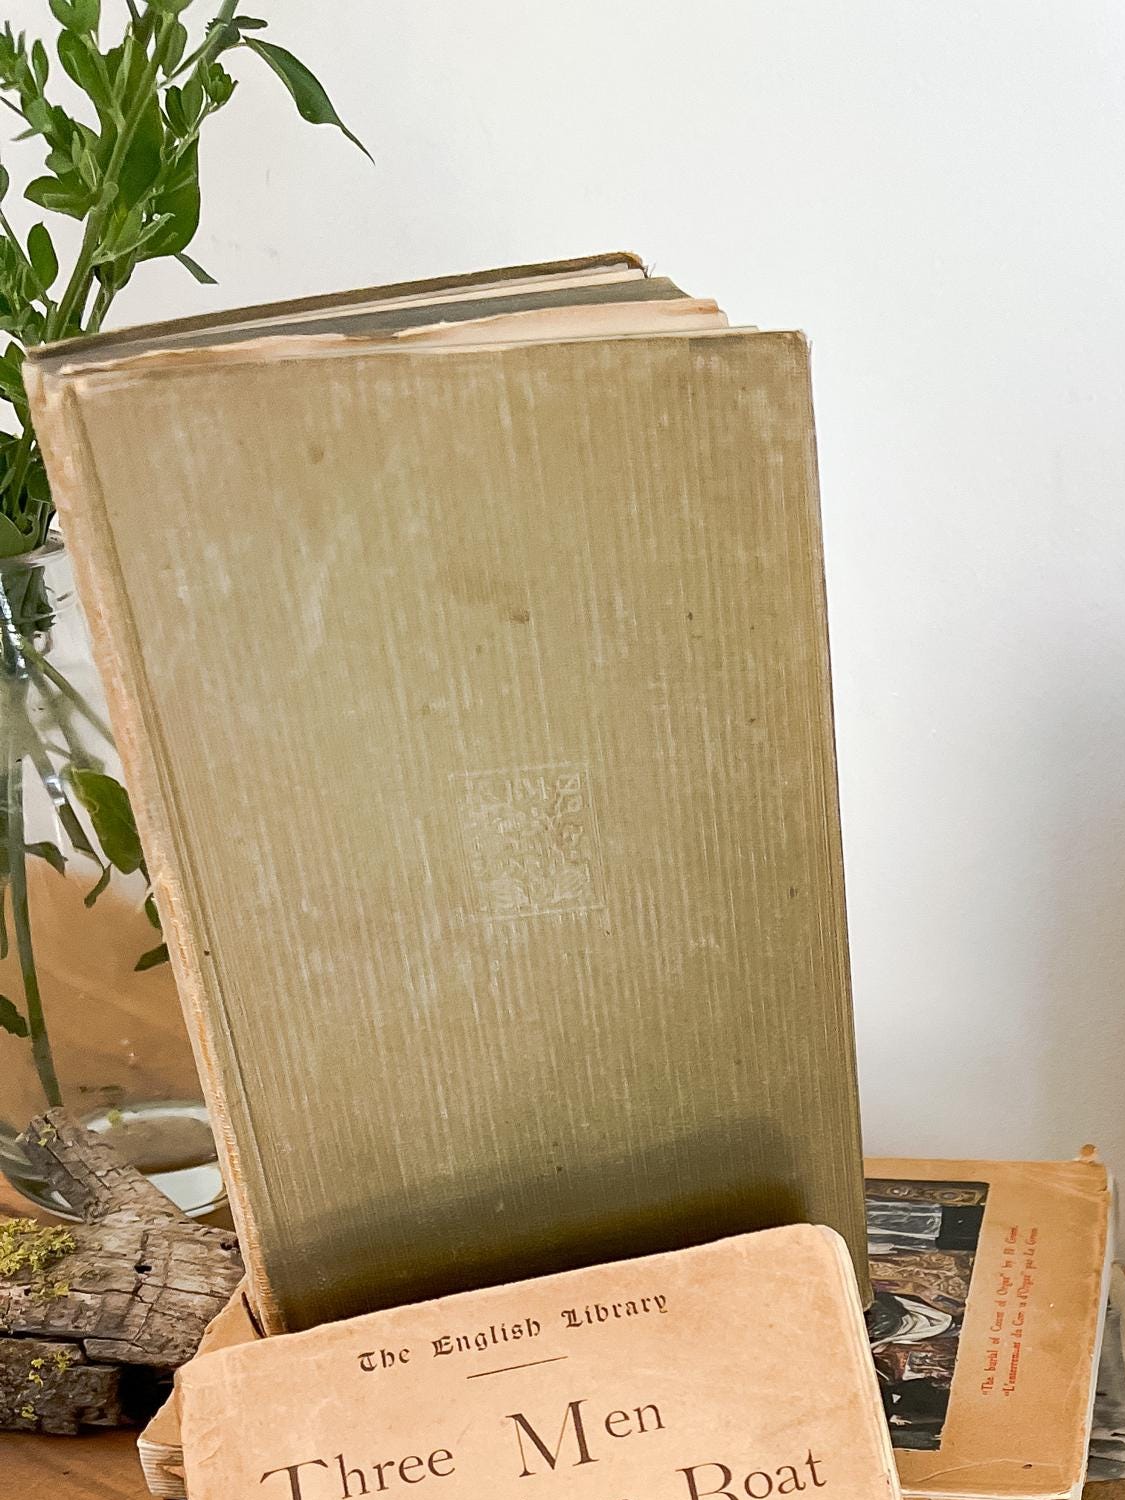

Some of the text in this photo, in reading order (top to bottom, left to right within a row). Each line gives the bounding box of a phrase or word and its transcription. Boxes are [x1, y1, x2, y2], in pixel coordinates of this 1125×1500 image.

[358, 1292, 668, 1372] The English Library
[505, 1398, 666, 1478] Men
